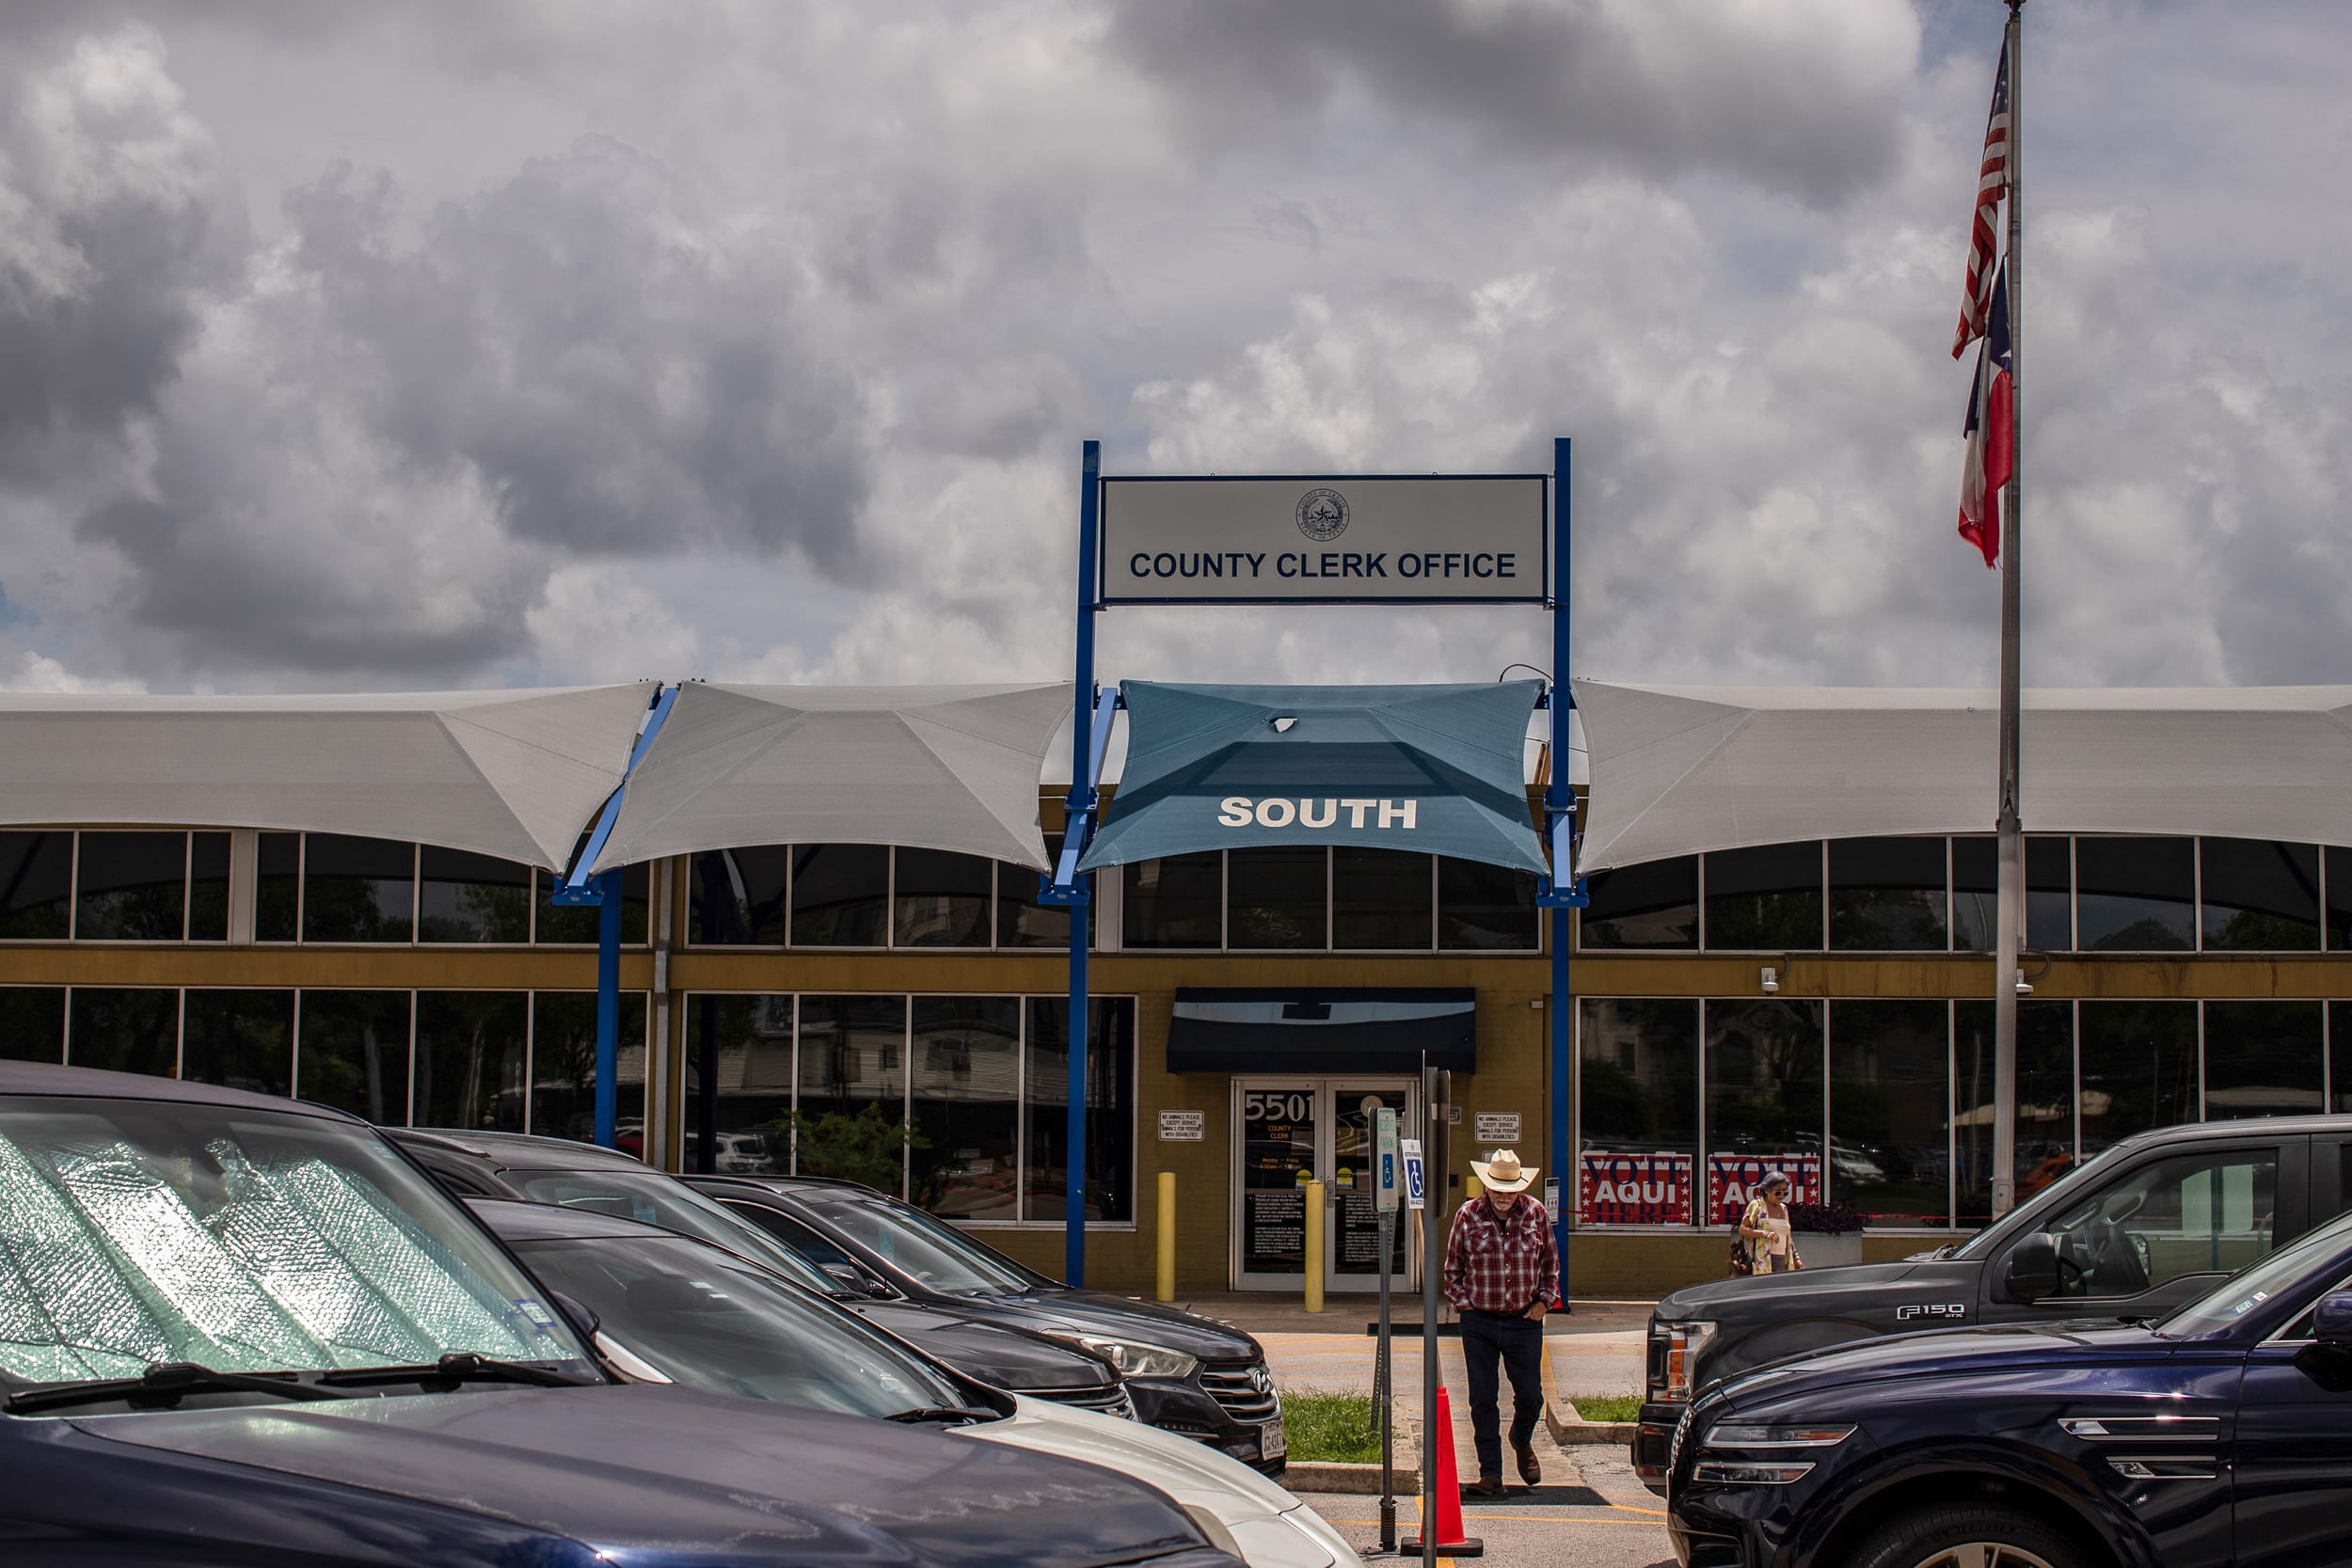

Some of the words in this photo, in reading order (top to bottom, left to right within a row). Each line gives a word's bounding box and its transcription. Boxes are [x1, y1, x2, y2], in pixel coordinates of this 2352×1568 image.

[1130, 552, 1266, 578] COUNTY
[1277, 552, 1388, 578] CLERK
[1398, 552, 1517, 578] OFFICE
[1217, 797, 1417, 830] SOUTH
[1245, 1094, 1314, 1122] 5501
[1583, 1155, 1690, 1185] VOTE
[1712, 1158, 1819, 1187] VOTE
[1595, 1180, 1676, 1204] AQUI
[1597, 1204, 1677, 1224] HERE
[1897, 1304, 1965, 1320] F150
